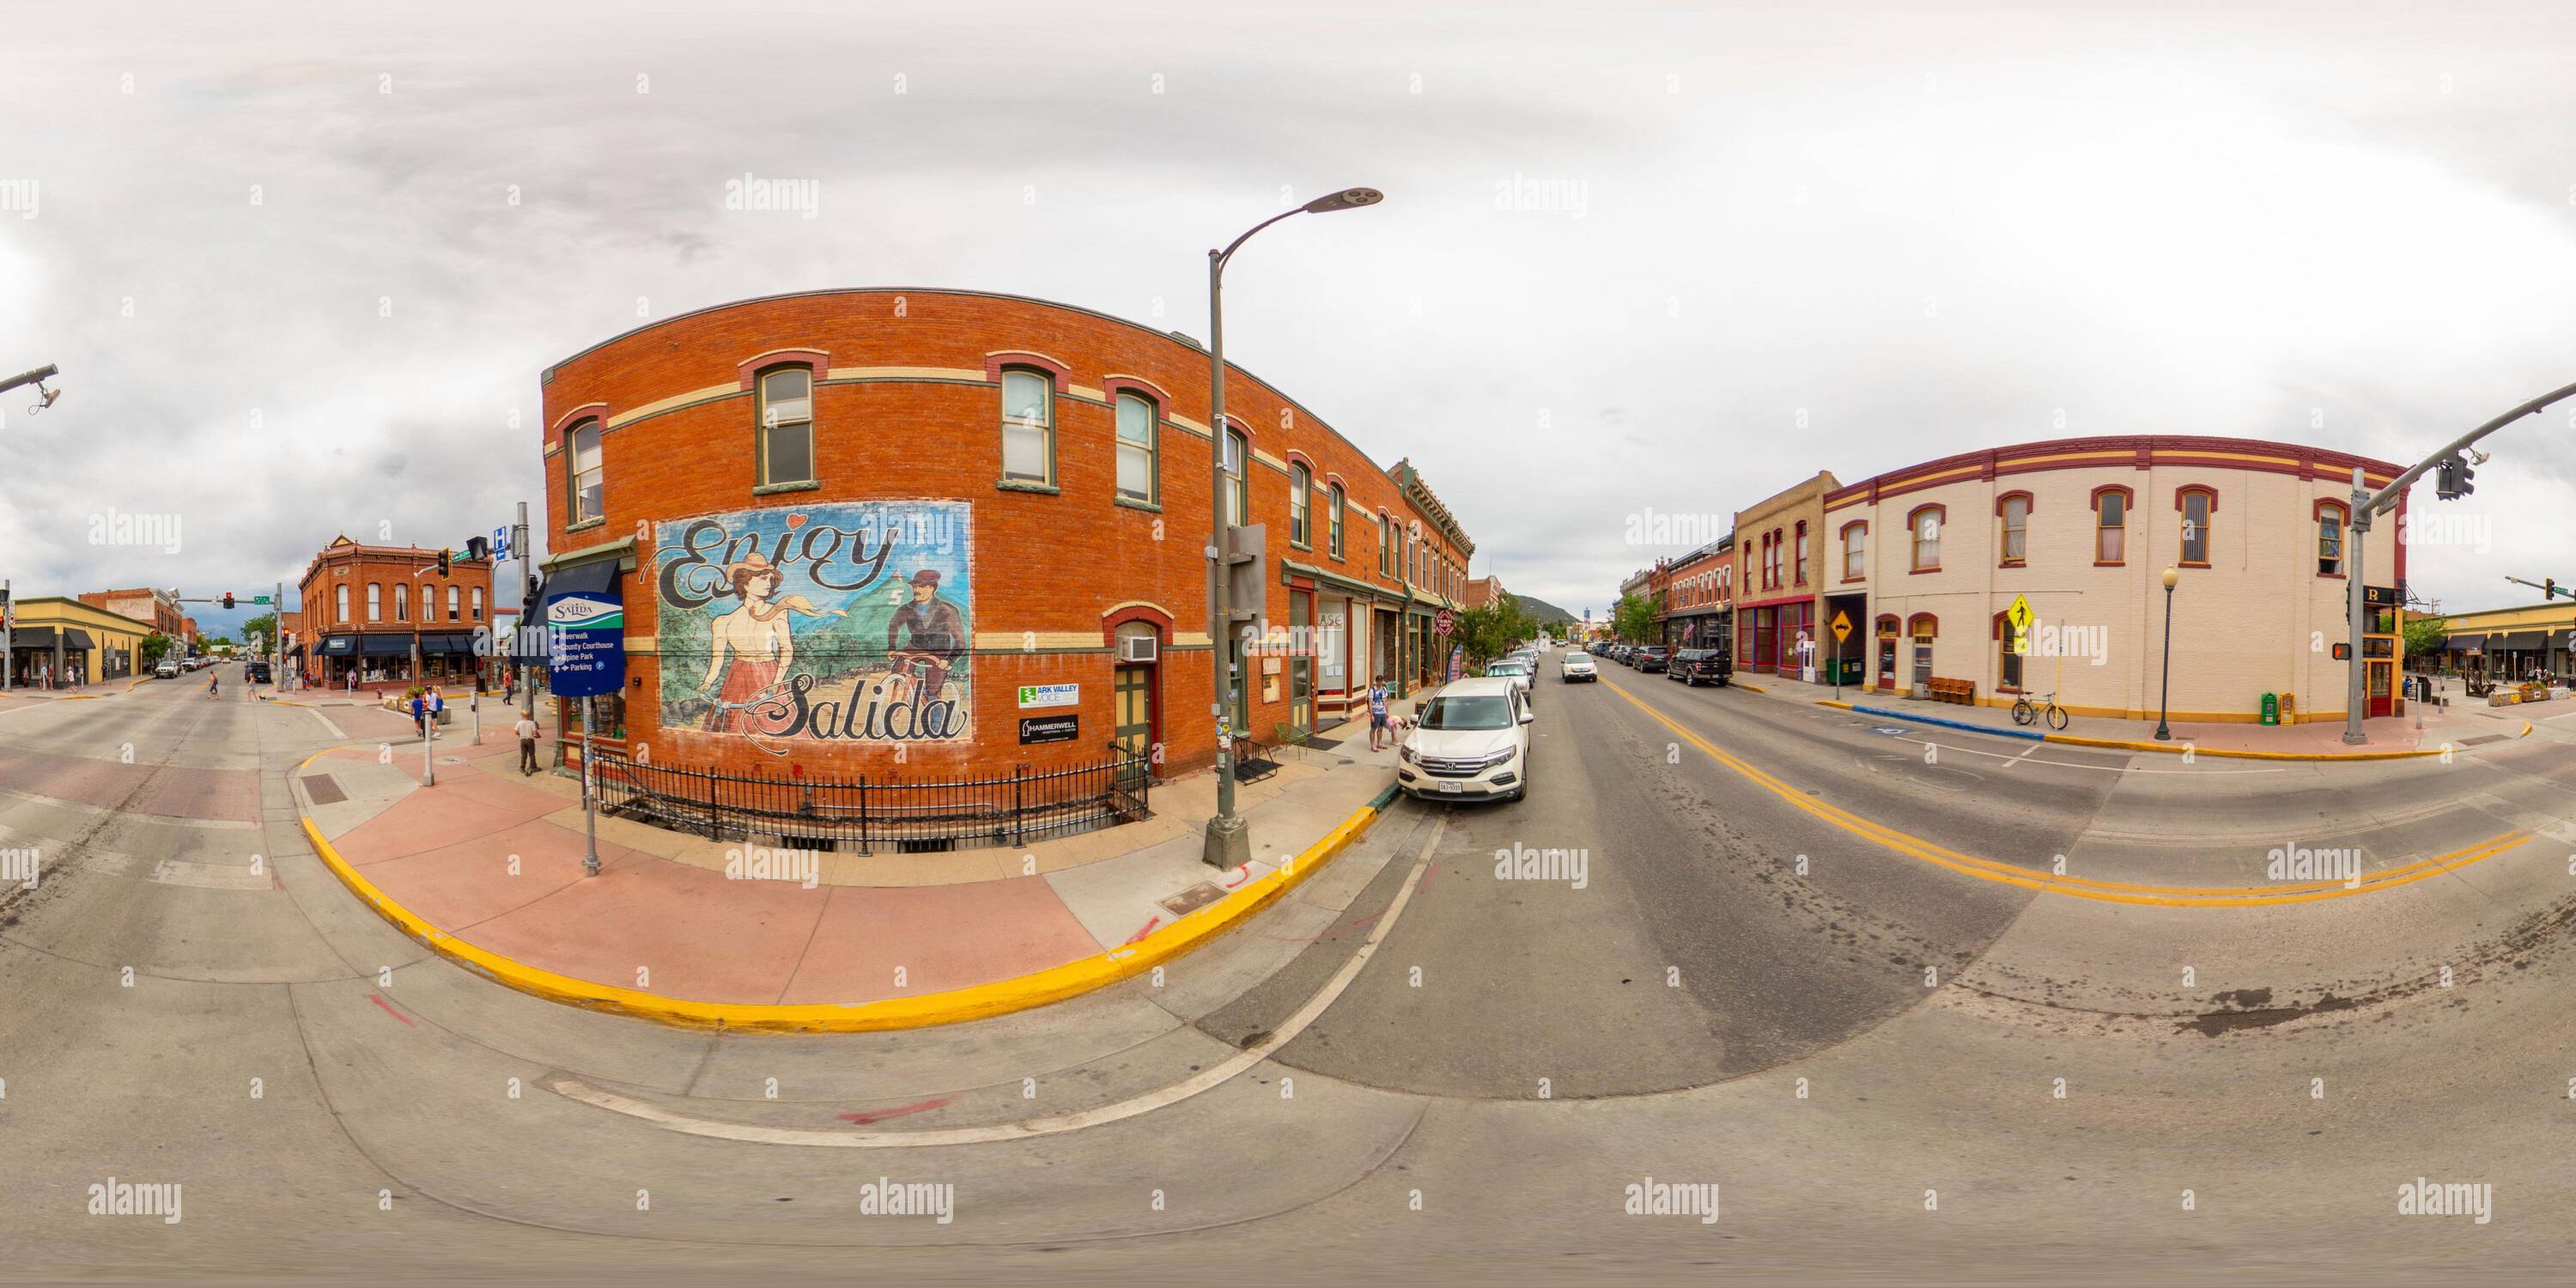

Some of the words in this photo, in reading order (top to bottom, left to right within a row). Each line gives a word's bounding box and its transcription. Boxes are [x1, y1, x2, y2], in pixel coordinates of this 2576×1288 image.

[639, 513, 900, 609] Enjoy
[583, 641, 614, 650] Courthouse
[560, 653, 579, 662] Alpine
[570, 663, 592, 671] Parking
[1037, 693, 1060, 702] VOICE
[740, 673, 967, 756] Salida
[1030, 722, 1076, 732] HAMMERWELL
